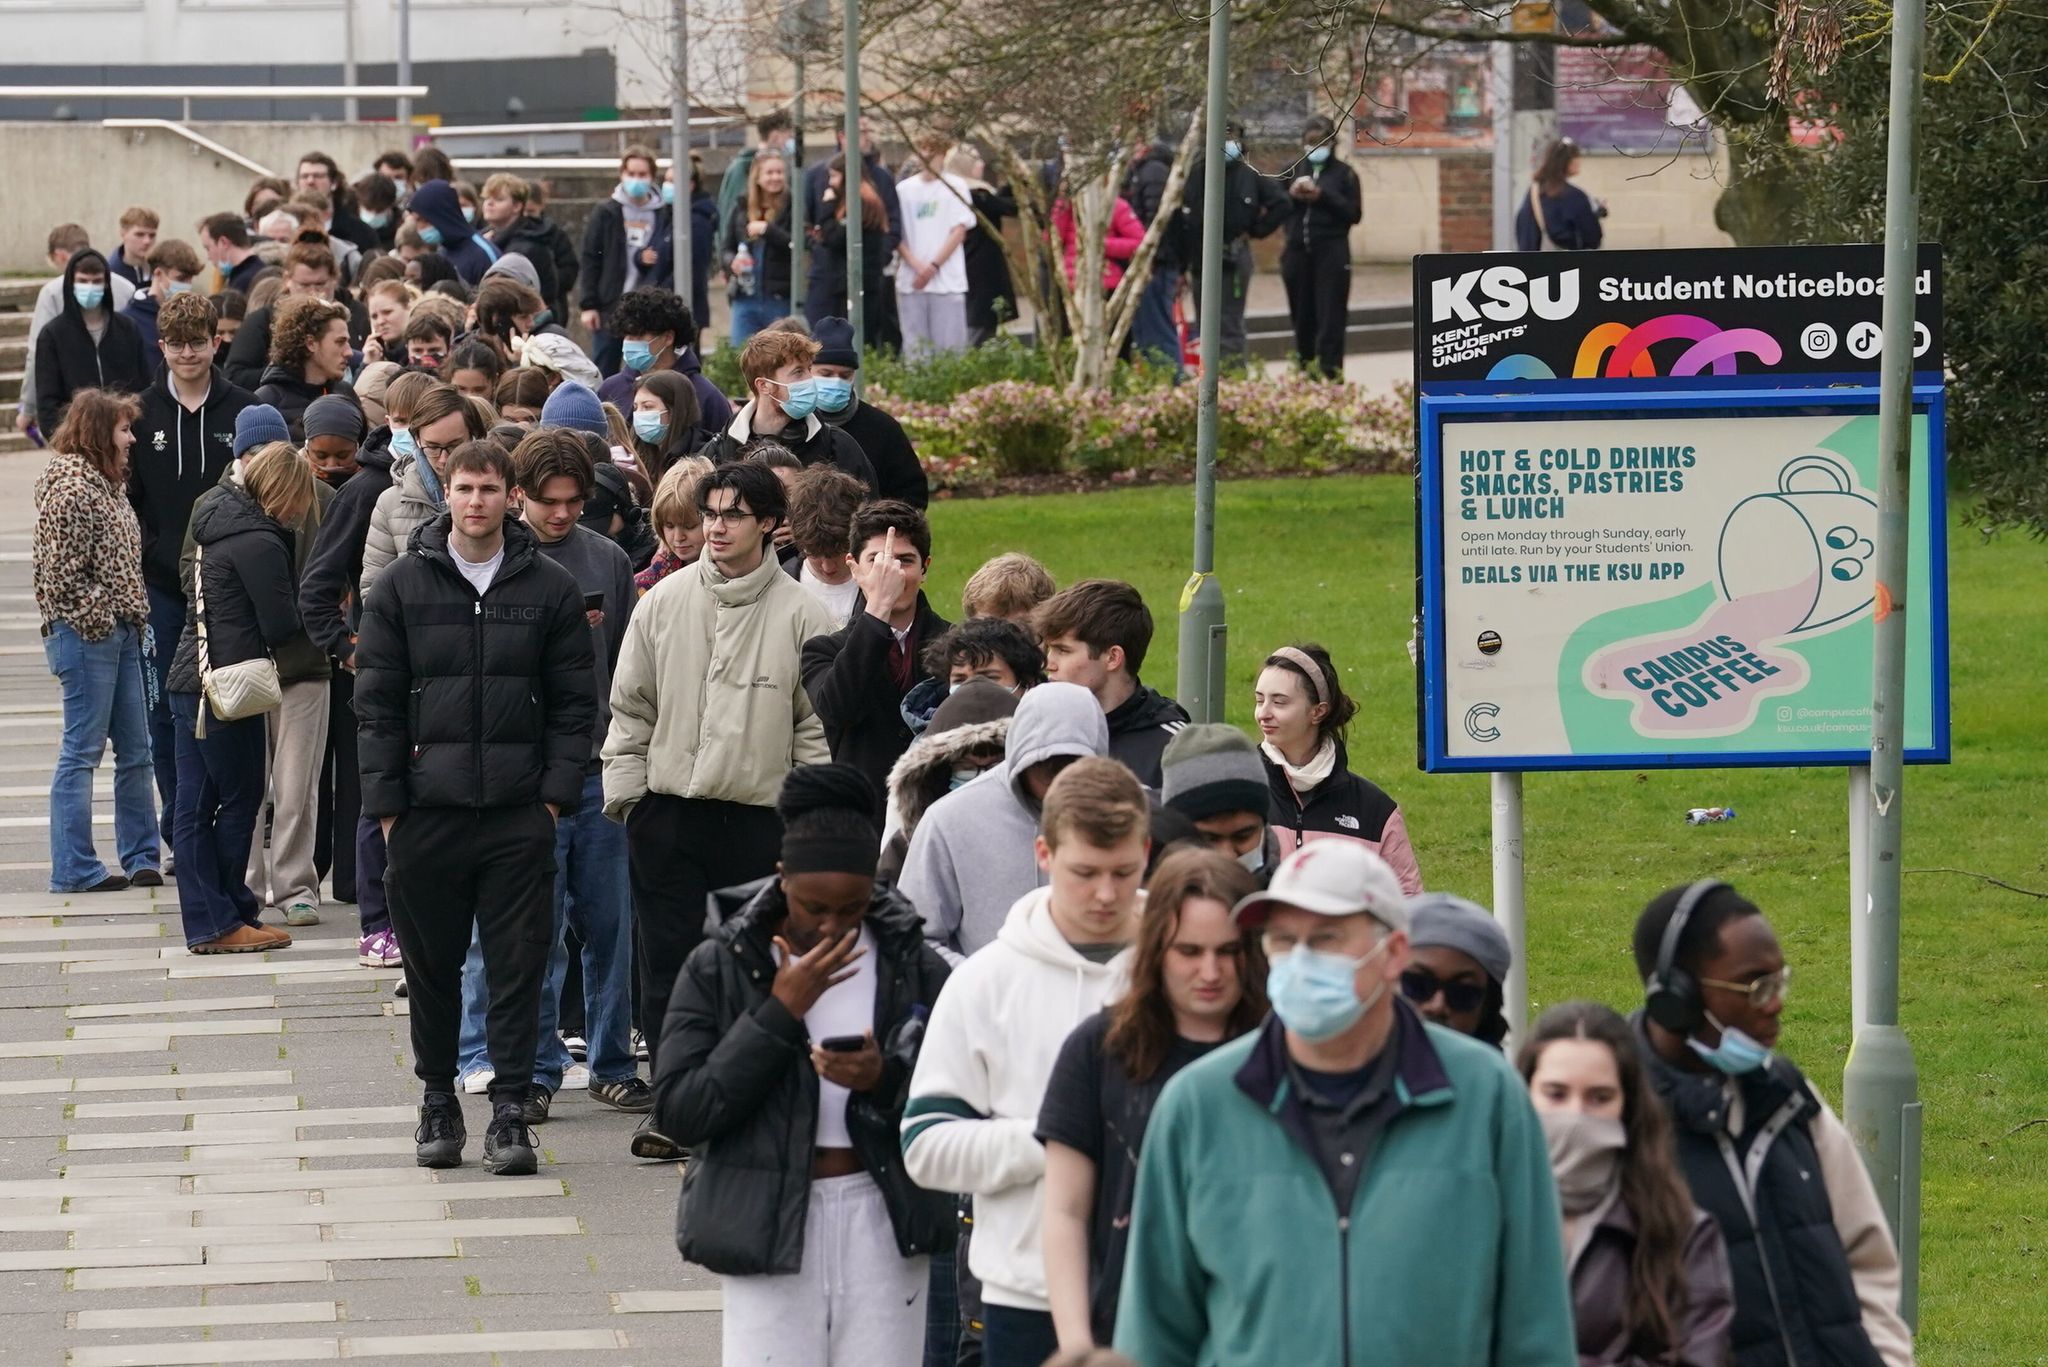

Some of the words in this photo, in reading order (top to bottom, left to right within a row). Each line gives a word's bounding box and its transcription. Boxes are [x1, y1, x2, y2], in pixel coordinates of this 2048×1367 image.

[1432, 266, 1580, 323] KSU
[1599, 275, 1725, 301] Student
[1733, 269, 1931, 298] Noticeboad
[1432, 323, 1483, 346] KENT
[1432, 324, 1528, 357] STUDENTS'
[1432, 345, 1488, 368] UNION
[1460, 450, 1505, 472] HOT
[1515, 450, 1530, 470] &
[1540, 448, 1600, 470] COLD
[1610, 446, 1696, 469] DRINKS
[1460, 473, 1559, 496] SNACKS,
[1569, 471, 1684, 494] PASTRIES
[1461, 498, 1477, 520] &
[1487, 496, 1564, 519] LUNCH
[1461, 531, 1494, 543] Open
[1497, 530, 1547, 542] Monday
[1550, 529, 1600, 542] through
[1603, 529, 1652, 541] Sunday,
[1655, 528, 1686, 540] early
[1461, 545, 1488, 556] until
[1491, 545, 1517, 555] late.
[1520, 545, 1543, 555] Run
[1546, 544, 1561, 557] by
[1564, 544, 1591, 556] your
[1595, 542, 1652, 554] Students'
[1655, 542, 1693, 553] Union.
[1462, 566, 1521, 584] DEALS
[1529, 565, 1558, 582] VIA
[1564, 564, 1600, 582] THE
[1607, 563, 1642, 581] KSU
[1649, 562, 1685, 580] APP
[1623, 635, 1747, 690] CAMPUS
[1651, 652, 1781, 717] COFFEE
